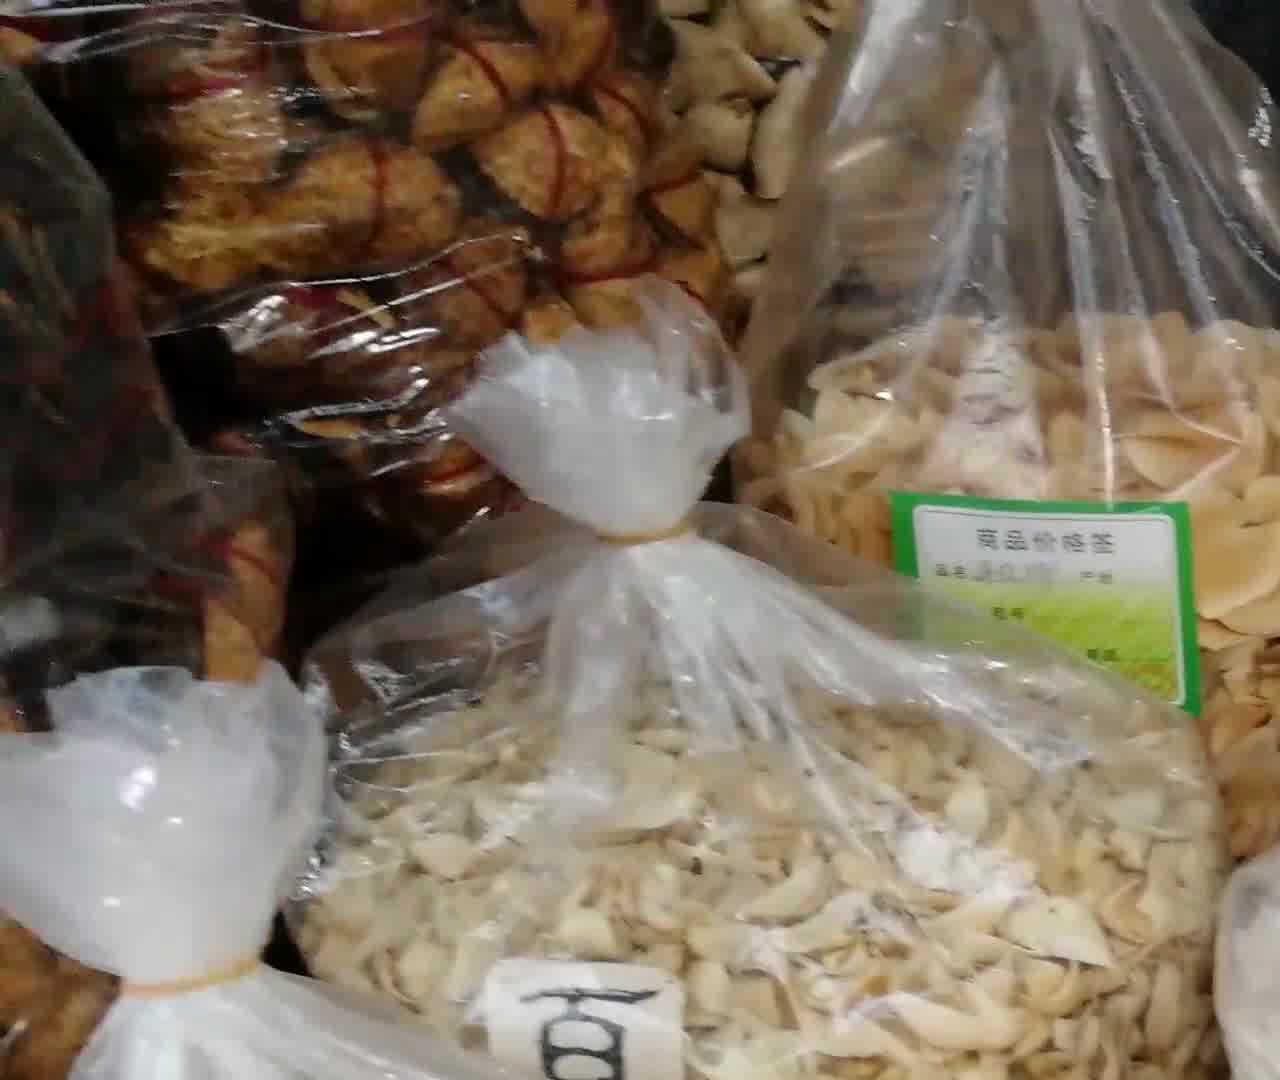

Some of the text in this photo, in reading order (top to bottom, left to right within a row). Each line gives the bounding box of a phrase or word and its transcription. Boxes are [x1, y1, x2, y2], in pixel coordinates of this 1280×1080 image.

[976, 528, 1116, 555] 商品价格签
